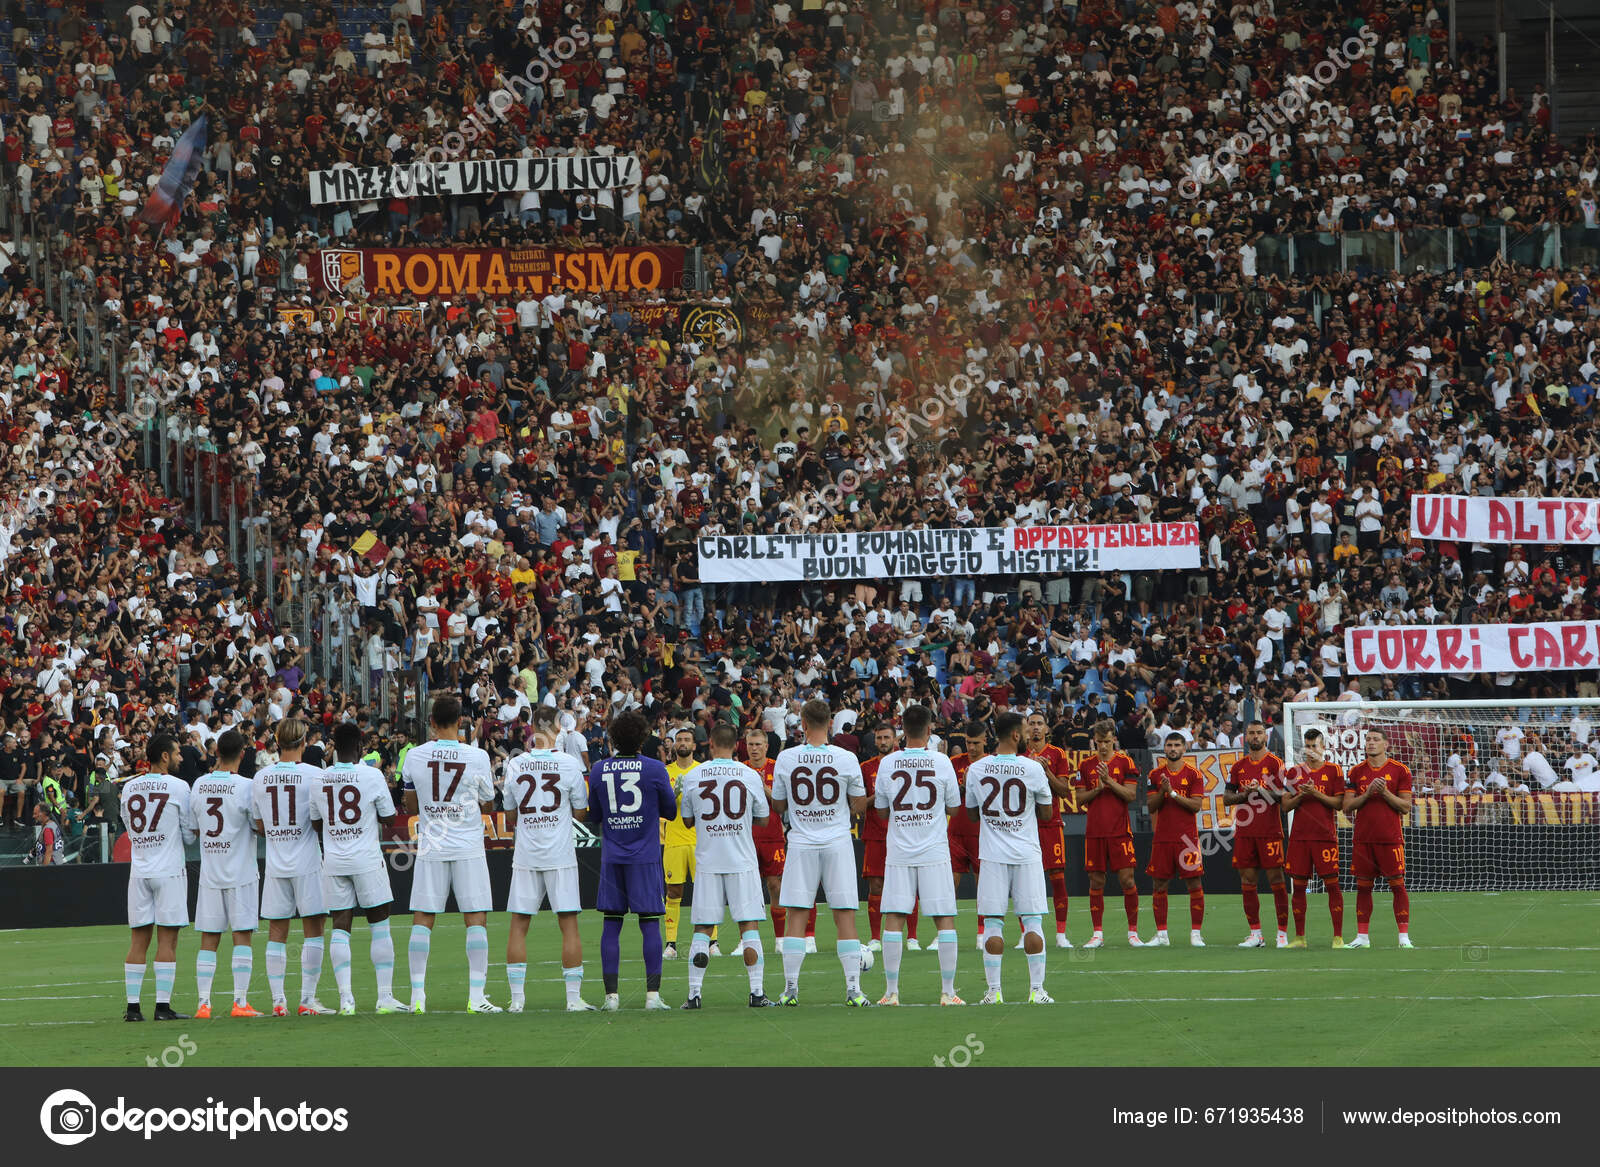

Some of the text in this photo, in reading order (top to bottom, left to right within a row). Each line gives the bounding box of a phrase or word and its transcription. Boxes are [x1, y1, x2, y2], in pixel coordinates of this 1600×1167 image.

[319, 162, 452, 203] MAZZONE
[459, 159, 519, 193] UNO
[1416, 497, 1600, 542] UN ALTR
[1013, 522, 1199, 550] APPARTENENZA
[803, 557, 867, 580] BUON
[1507, 624, 1600, 669] CAR
[431, 750, 459, 760] FAZIO
[519, 761, 559, 773] GYOMBER
[603, 760, 642, 772] G.OCHOA
[798, 754, 833, 764] LOVATO
[894, 759, 935, 769] MAGGIORE
[983, 762, 1025, 776] KASTANOS
[263, 774, 302, 785] BOTHEIM
[427, 761, 466, 802] 17
[701, 766, 744, 778] MAZZOCCHI
[791, 766, 840, 806] 66
[516, 773, 562, 815] 23
[601, 772, 643, 814] 13
[698, 779, 747, 821] 30
[890, 769, 937, 812] 25
[979, 776, 1027, 818] 20
[127, 792, 170, 834] 87
[205, 797, 224, 838] 3
[265, 785, 297, 827] 11
[322, 785, 362, 827] 18
[1053, 843, 1062, 857] 6
[1121, 841, 1135, 855] 14
[1185, 852, 1201, 865] 22
[1266, 841, 1280, 857] 37
[1321, 847, 1338, 863] 92
